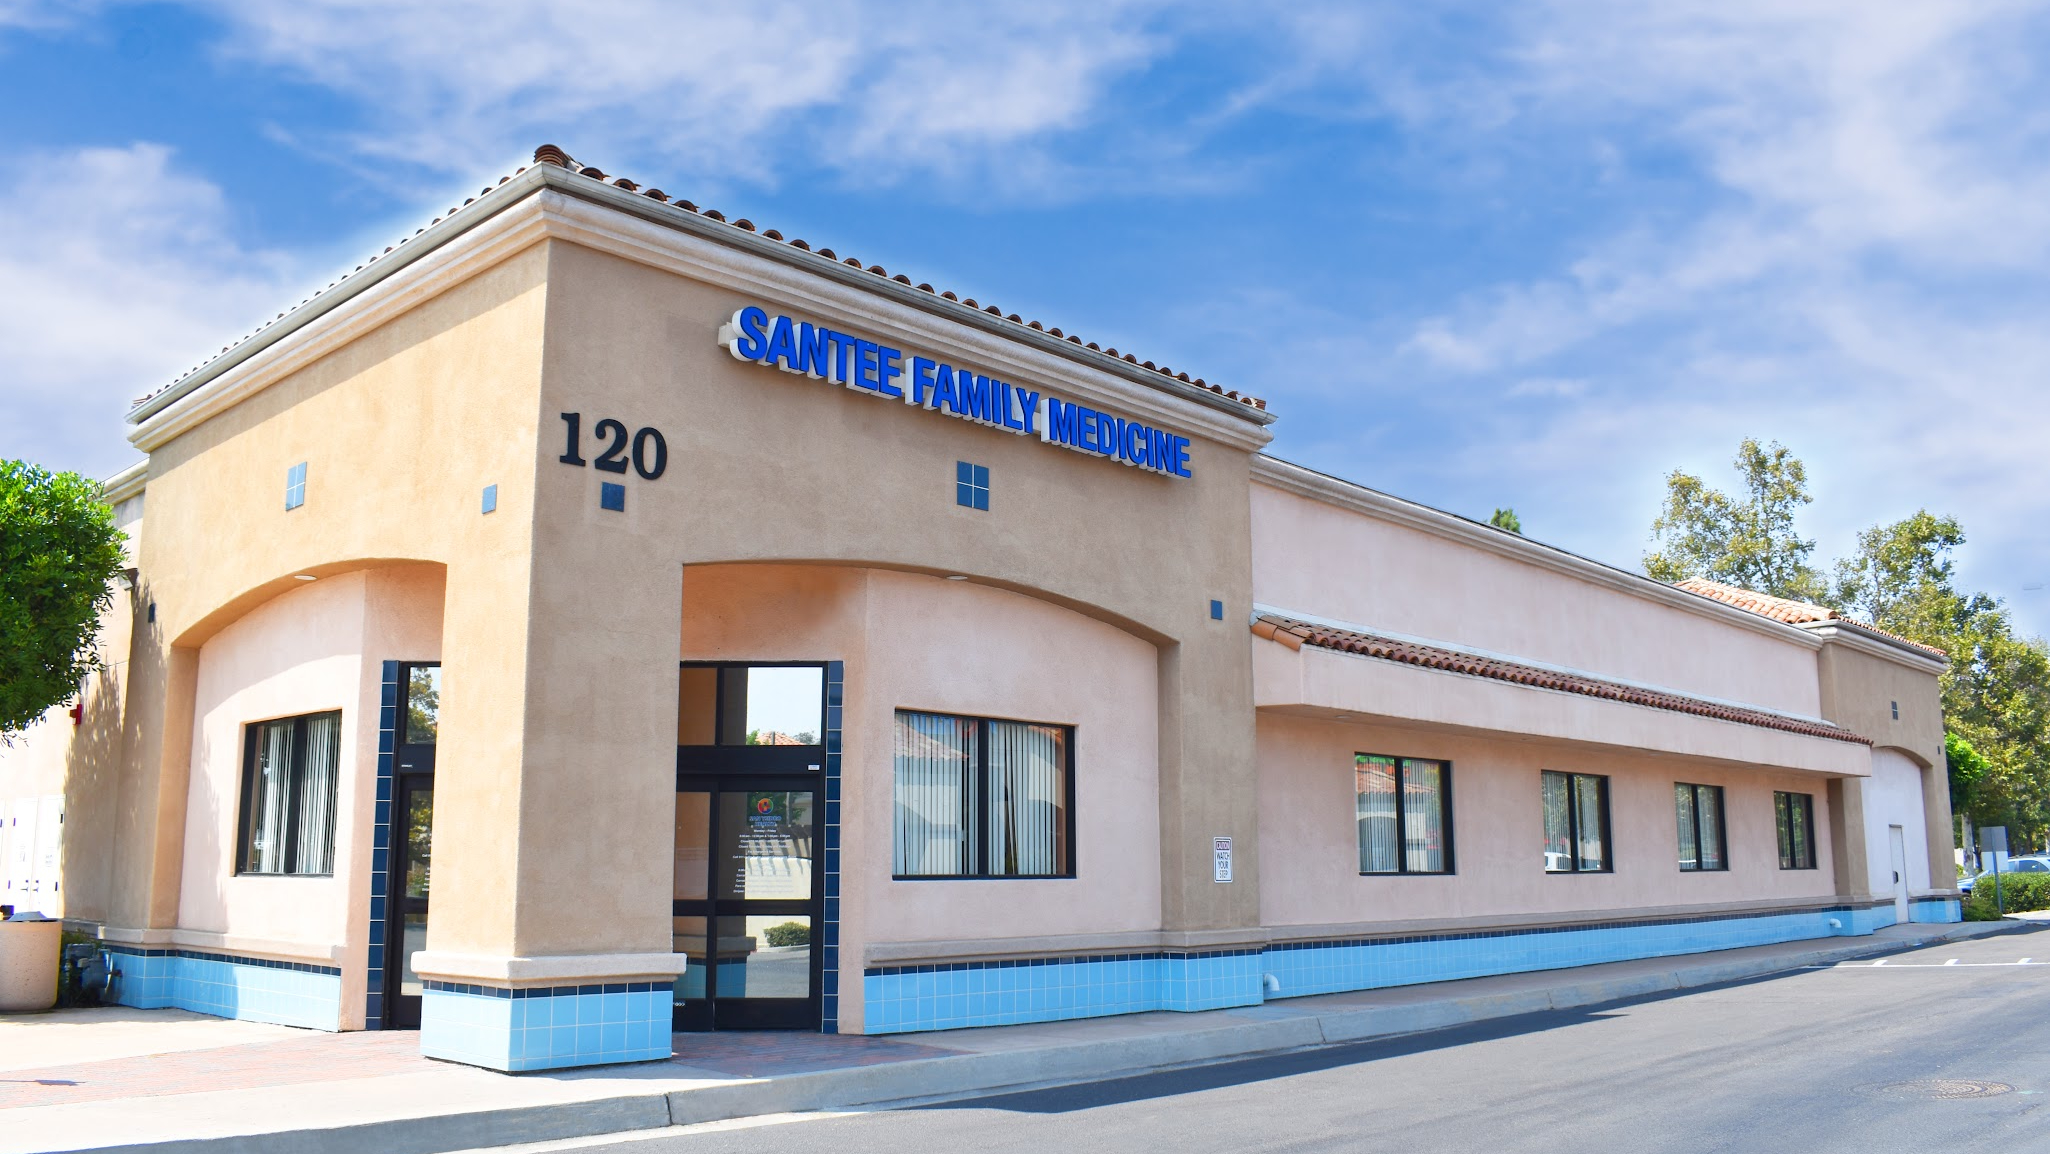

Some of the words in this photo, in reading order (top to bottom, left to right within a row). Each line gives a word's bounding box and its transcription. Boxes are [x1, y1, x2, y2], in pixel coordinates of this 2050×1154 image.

[559, 412, 668, 481] 120
[736, 306, 902, 397] SANTEE
[912, 356, 1040, 434] FAMILY
[1048, 397, 1192, 479] MEDICINE
